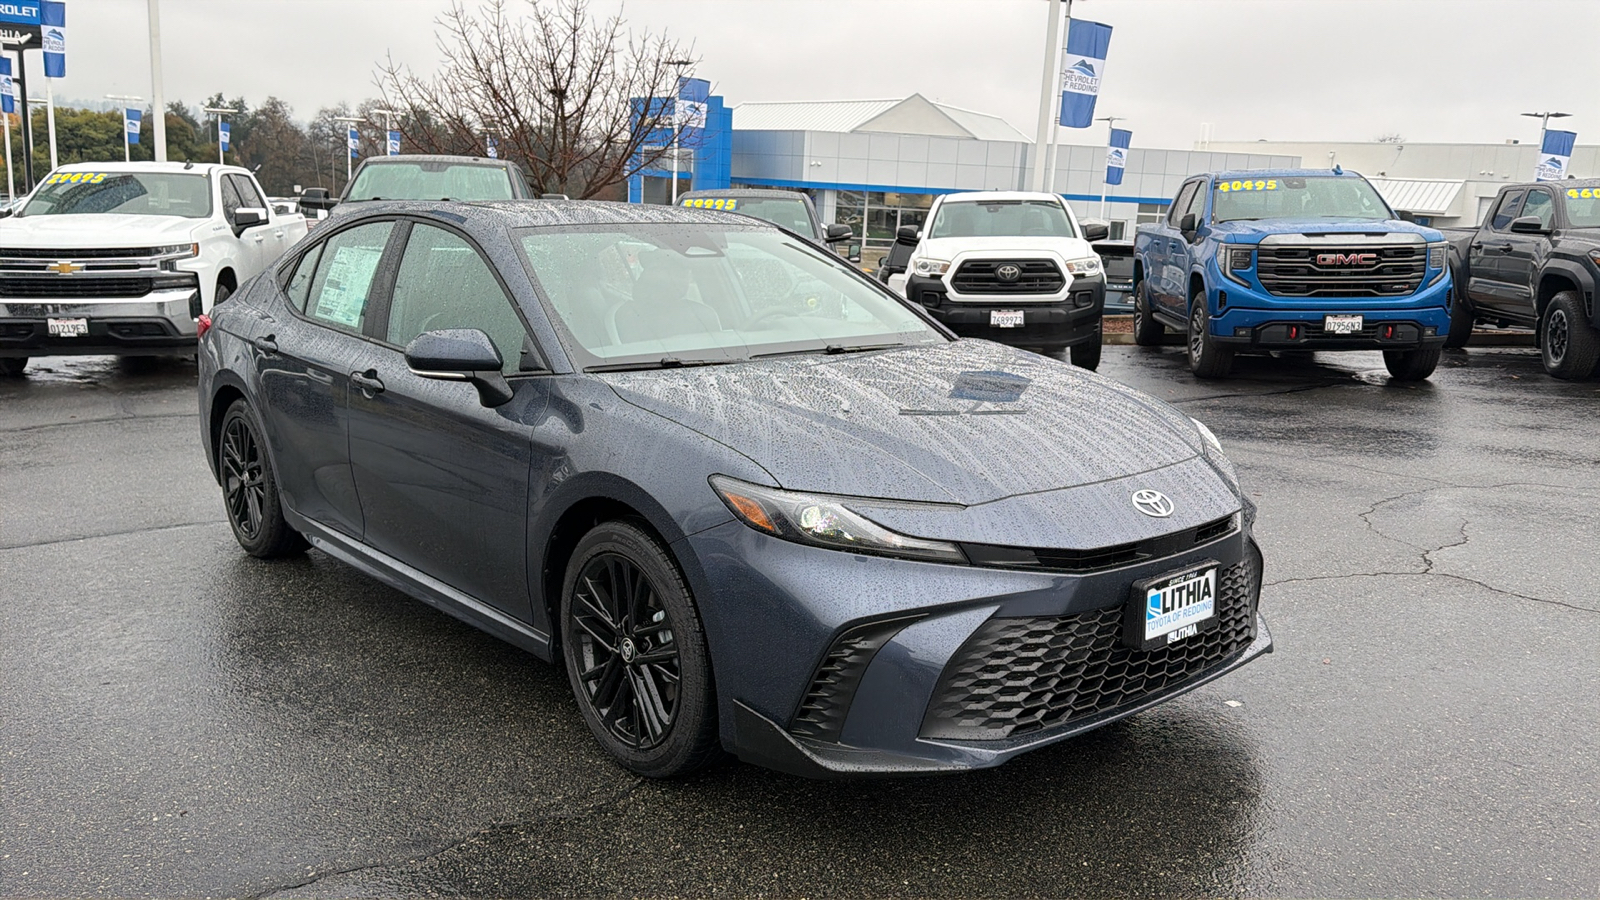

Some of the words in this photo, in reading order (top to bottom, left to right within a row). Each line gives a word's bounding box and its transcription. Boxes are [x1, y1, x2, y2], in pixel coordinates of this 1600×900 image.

[1069, 82, 1098, 93] REDDING
[1218, 179, 1277, 192] 40495
[1317, 253, 1377, 265] GMC
[50, 324, 87, 334] 01219E3
[1326, 321, 1361, 331] 07956N3
[1162, 577, 1212, 615] LITHIA
[1147, 615, 1171, 632] TOYOTA
[1172, 611, 1182, 621] OF
[1183, 600, 1212, 618] REDDING
[1175, 623, 1197, 639] LITHIA
